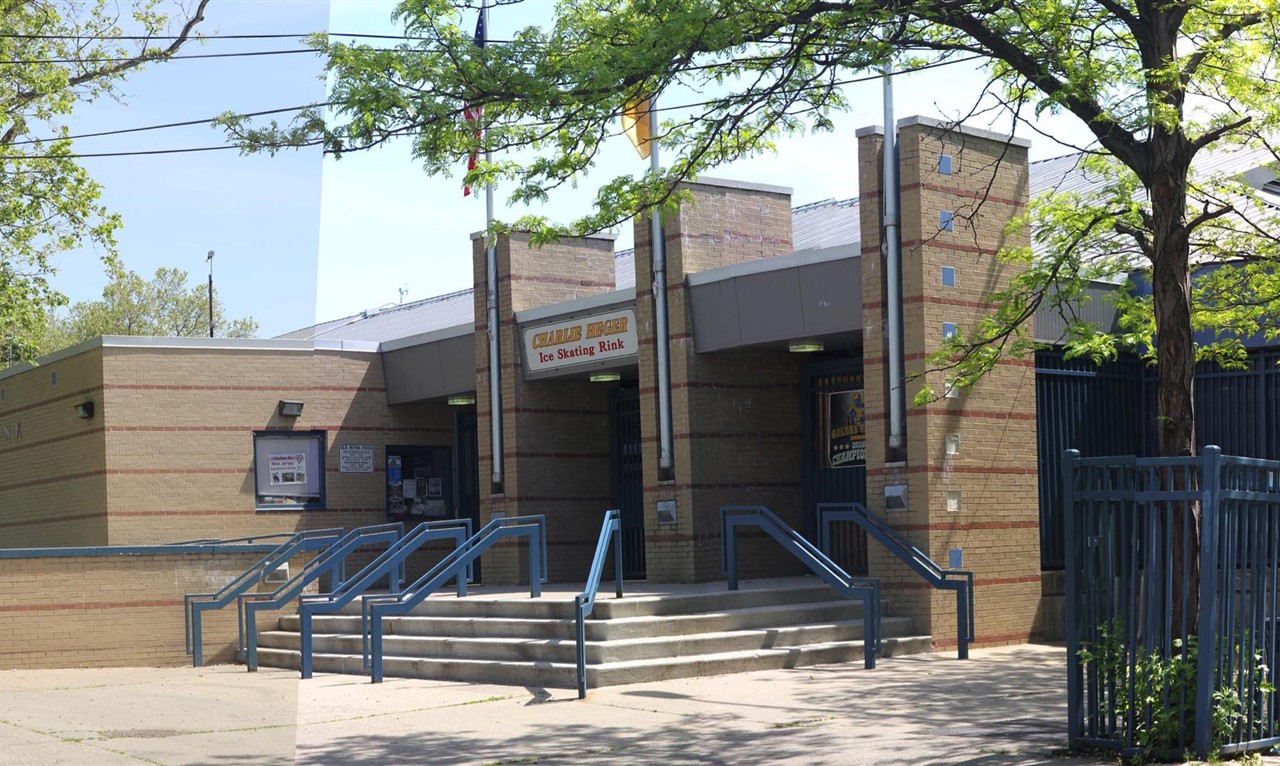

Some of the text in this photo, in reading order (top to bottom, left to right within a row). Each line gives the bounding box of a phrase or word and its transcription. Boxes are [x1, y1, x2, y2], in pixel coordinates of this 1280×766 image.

[532, 316, 629, 350] CHARLIE HEGER
[538, 338, 625, 363] Ice Skating Rink
[832, 449, 866, 467] CHAMPIO
